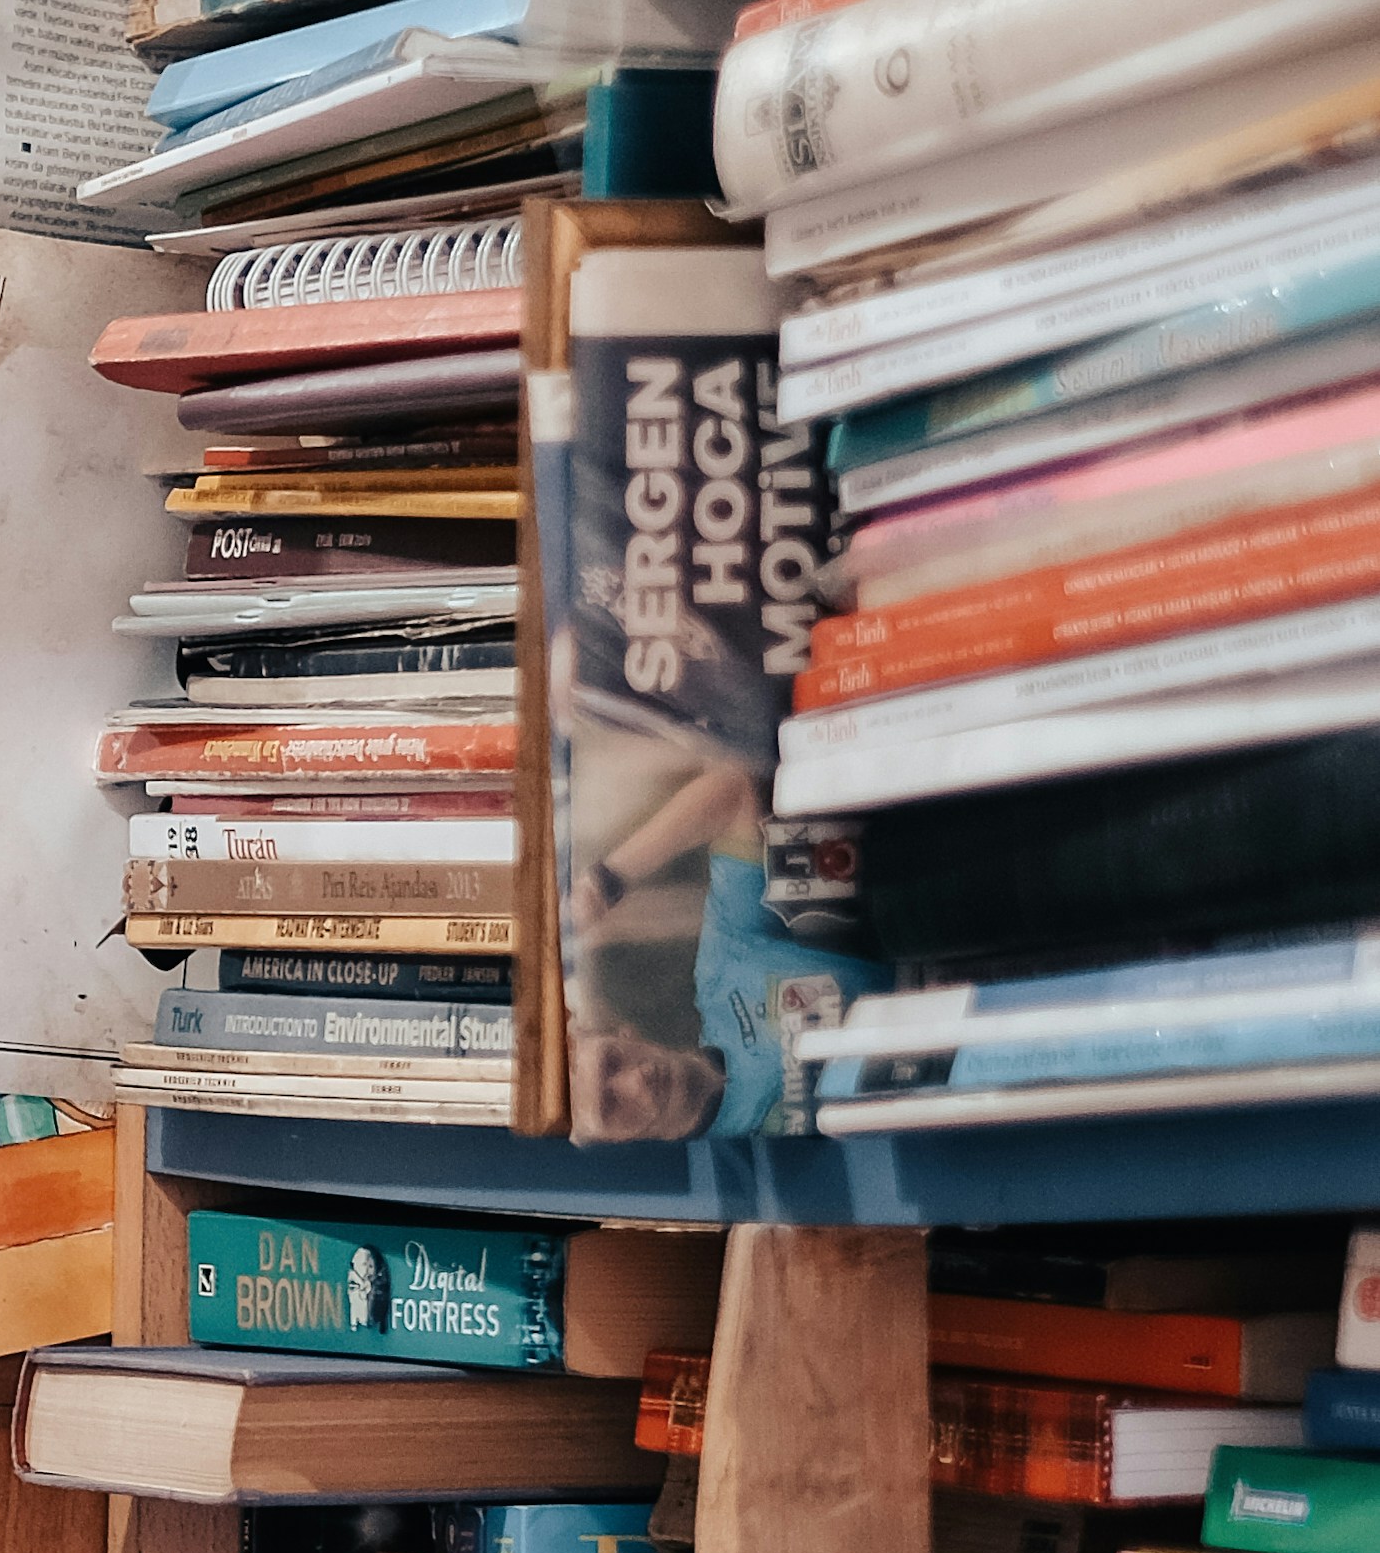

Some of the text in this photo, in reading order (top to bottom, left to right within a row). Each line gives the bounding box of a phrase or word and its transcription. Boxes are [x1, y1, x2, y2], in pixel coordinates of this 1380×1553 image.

[693, 357, 748, 604] HOCA
[625, 356, 682, 694] SERGEN
[222, 828, 278, 860] Turán
[349, 872, 377, 895] Reis
[447, 872, 480, 899] 2013
[242, 955, 400, 986] AMERICA IN CLOSE-UP
[171, 1007, 204, 1035] Turk
[224, 1010, 514, 1051] INTRODUCTION TO Environmental Studi
[258, 1231, 319, 1273] DAN
[404, 1241, 487, 1294] Digital
[236, 1275, 342, 1333] BROWN
[390, 1297, 500, 1340] FORTRESS
